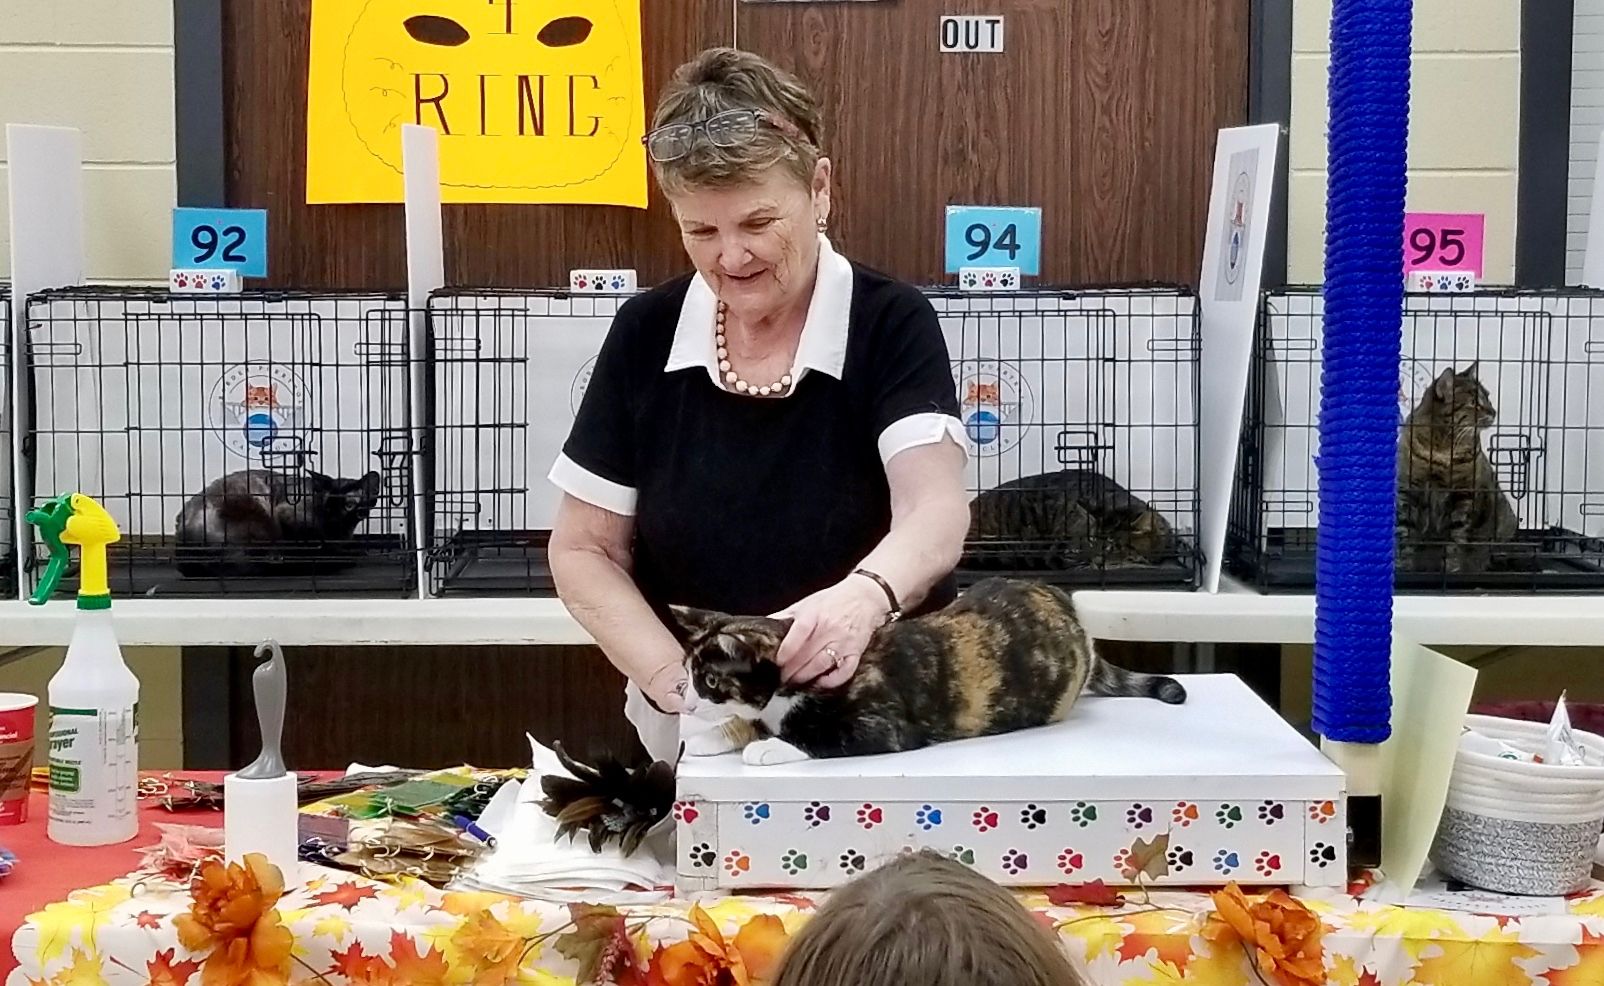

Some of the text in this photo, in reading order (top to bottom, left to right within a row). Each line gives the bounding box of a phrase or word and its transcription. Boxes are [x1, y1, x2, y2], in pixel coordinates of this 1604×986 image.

[941, 18, 1001, 50] OUT
[408, 73, 604, 137] RING
[190, 224, 247, 264] 92
[964, 223, 1021, 261] 94
[1409, 227, 1465, 267] 95
